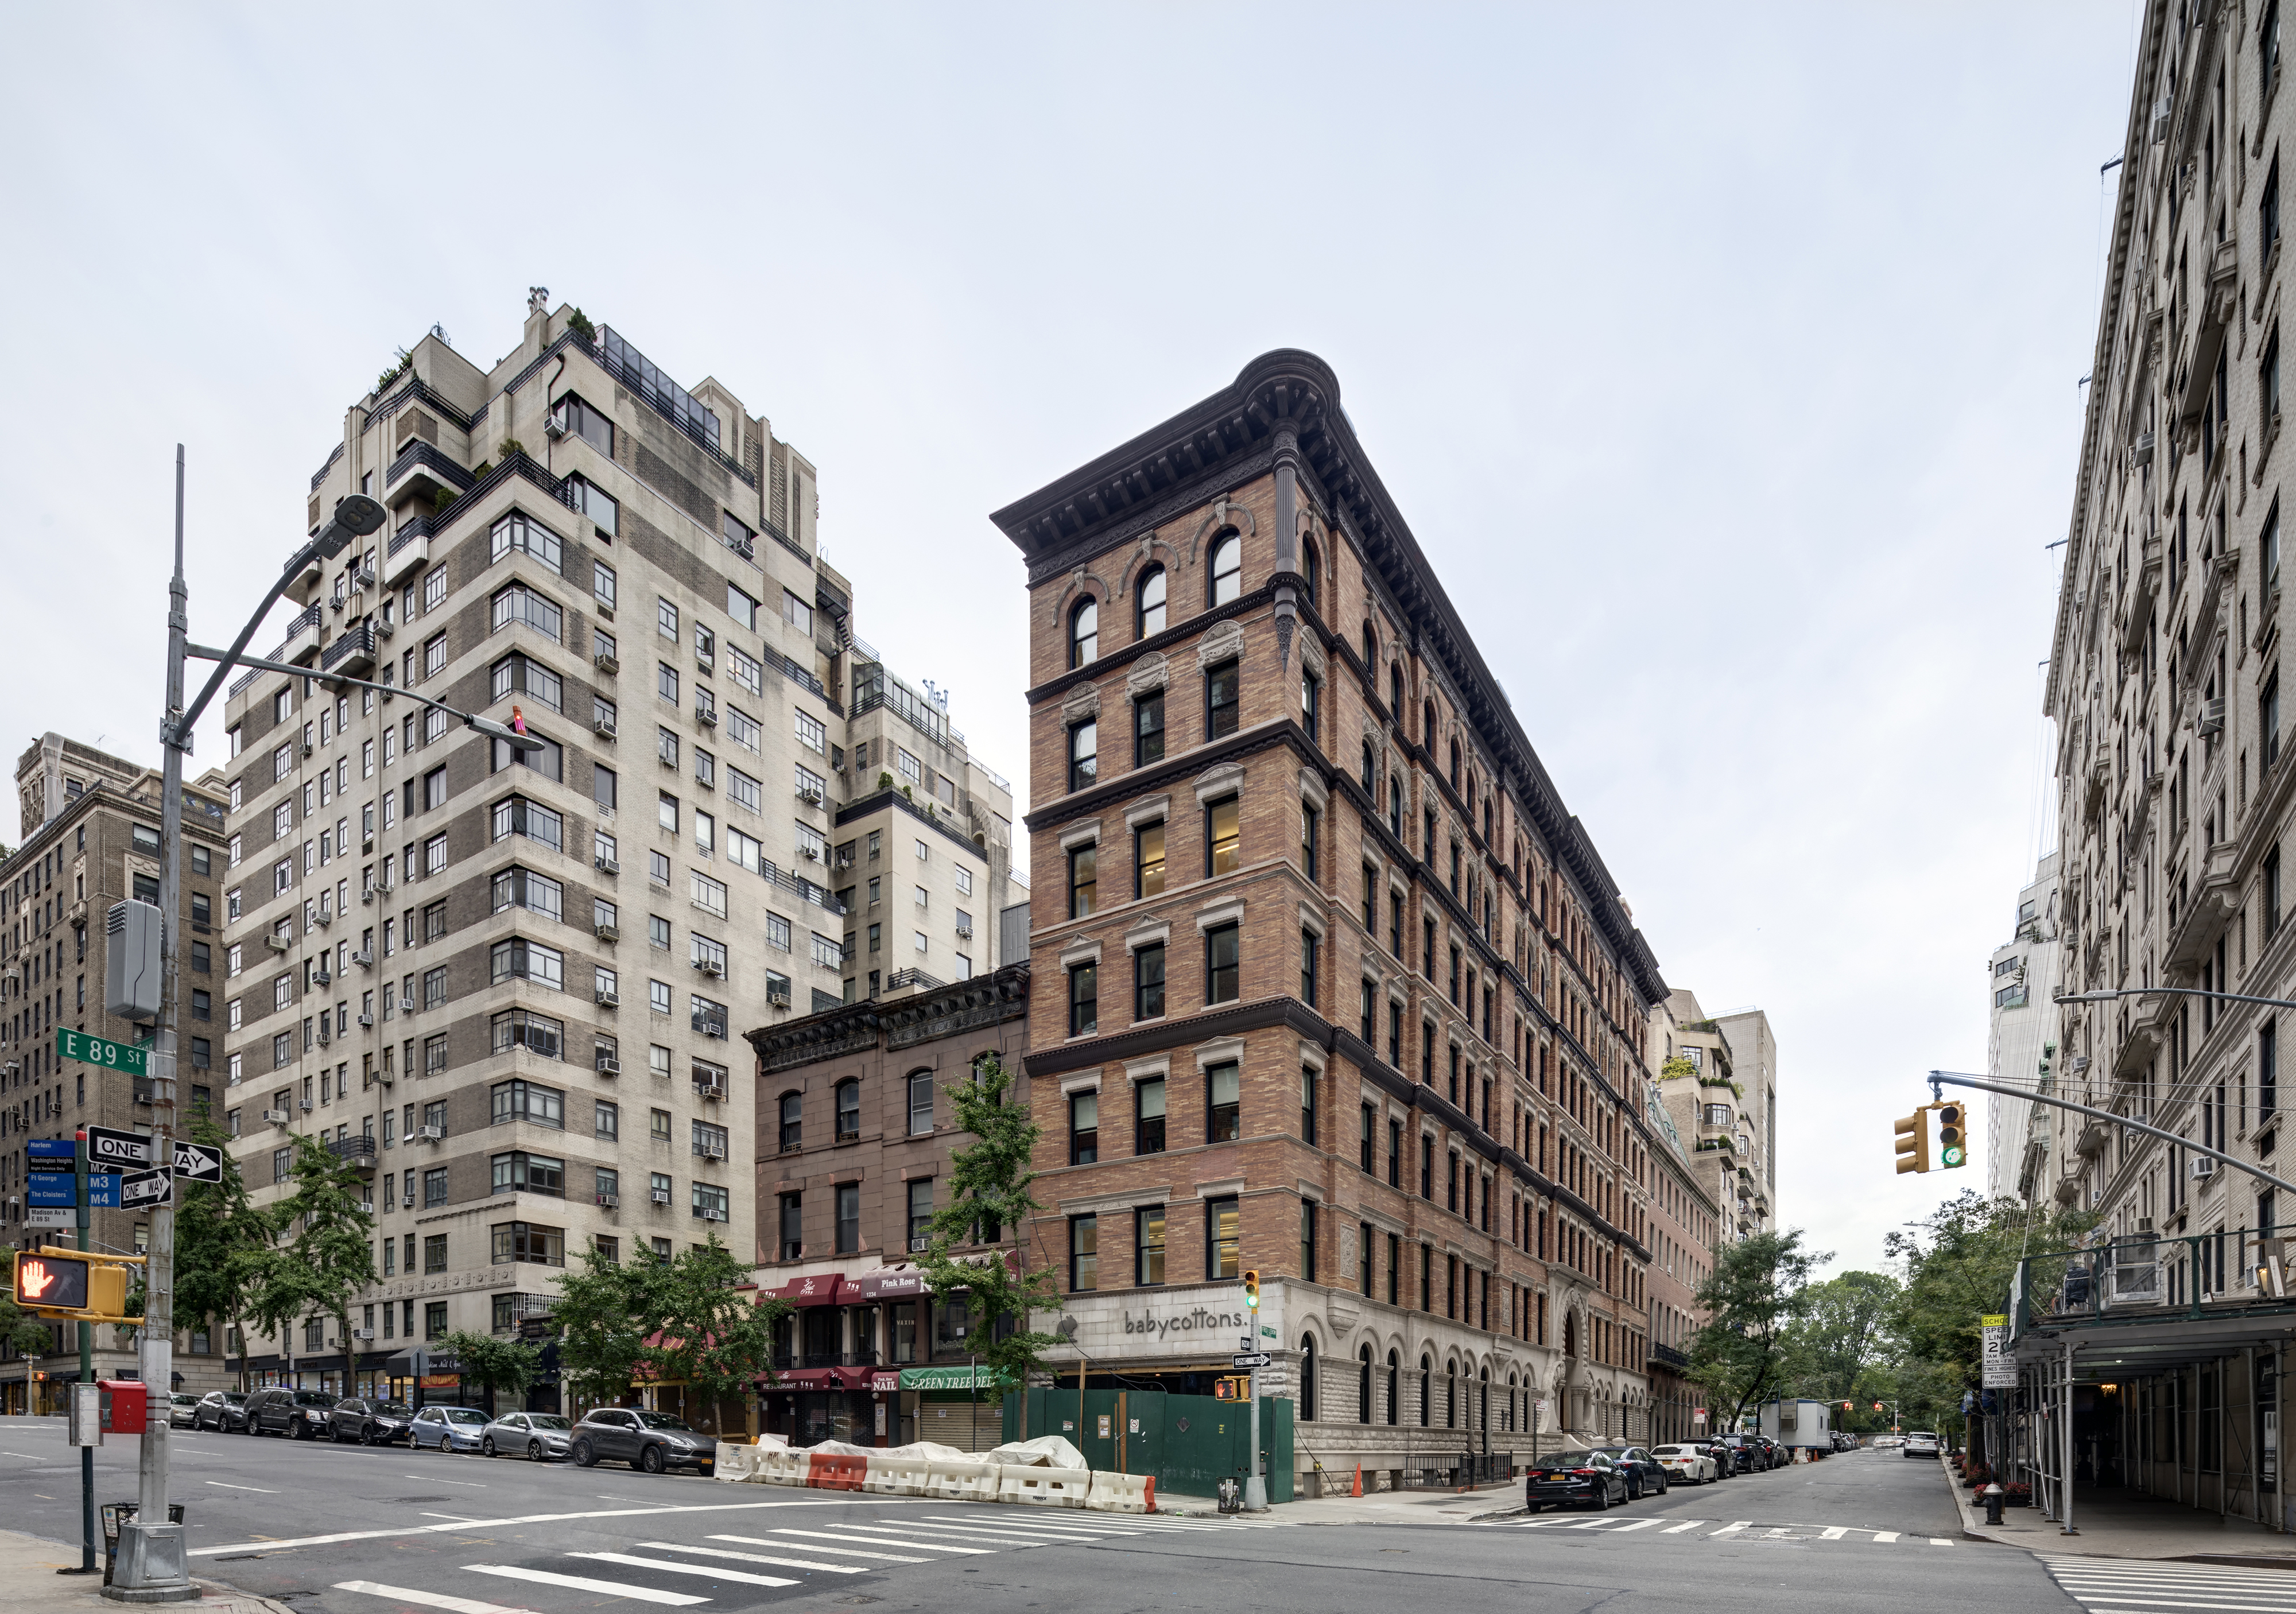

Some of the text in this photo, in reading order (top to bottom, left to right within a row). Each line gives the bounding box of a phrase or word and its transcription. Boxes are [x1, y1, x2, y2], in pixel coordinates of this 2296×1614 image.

[327, 540, 339, 548] LED
[67, 1033, 77, 1056] E
[90, 1040, 117, 1065] 89
[127, 1050, 141, 1065] St
[102, 1139, 204, 1168] ONE AY
[91, 1163, 108, 1173] M2
[90, 1176, 108, 1188] M3
[125, 1178, 165, 1199] ONE WAY
[91, 1193, 109, 1204] M4
[881, 1279, 897, 1287] Pink
[899, 1277, 915, 1286] Rose
[1126, 1306, 1248, 1339] babycottons.
[439, 1359, 448, 1368] Nail
[422, 1375, 437, 1385] GRAND
[873, 1381, 897, 1390] NAIL
[910, 1378, 944, 1390] GREEN
[947, 1378, 972, 1389] TREE
